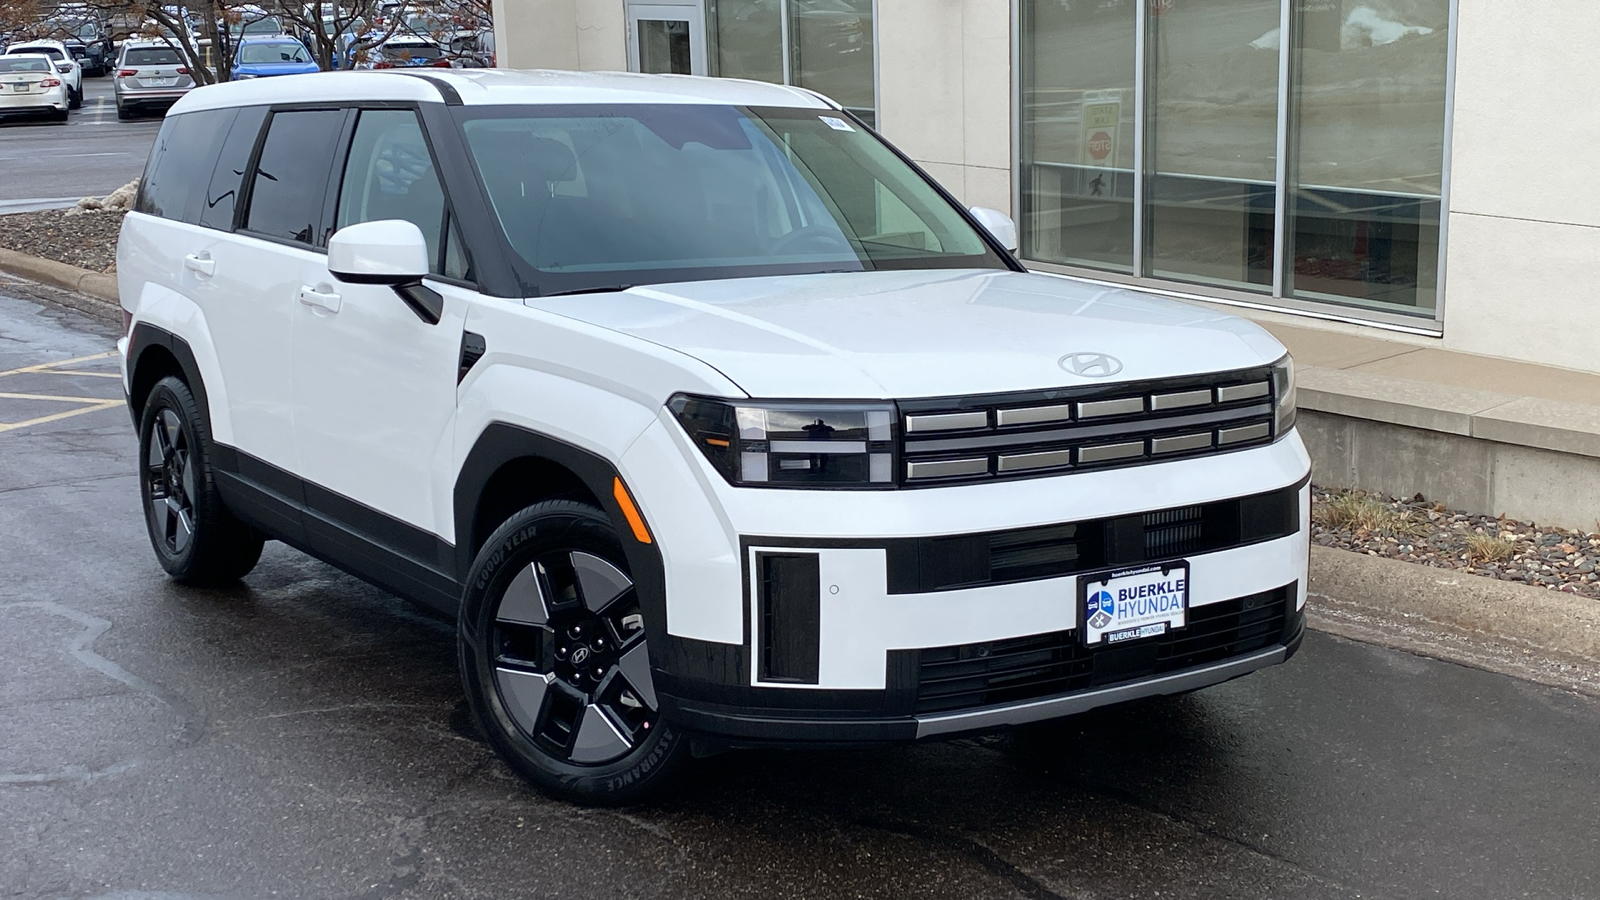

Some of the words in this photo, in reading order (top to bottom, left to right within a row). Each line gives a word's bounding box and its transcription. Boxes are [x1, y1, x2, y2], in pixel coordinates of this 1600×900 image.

[1119, 579, 1184, 601] BUERKLE
[1118, 592, 1184, 619] HYUNDAI
[1109, 629, 1141, 641] BUERKLE
[1141, 624, 1163, 636] HYUNDAI
[607, 727, 673, 792] ASSURANCE
